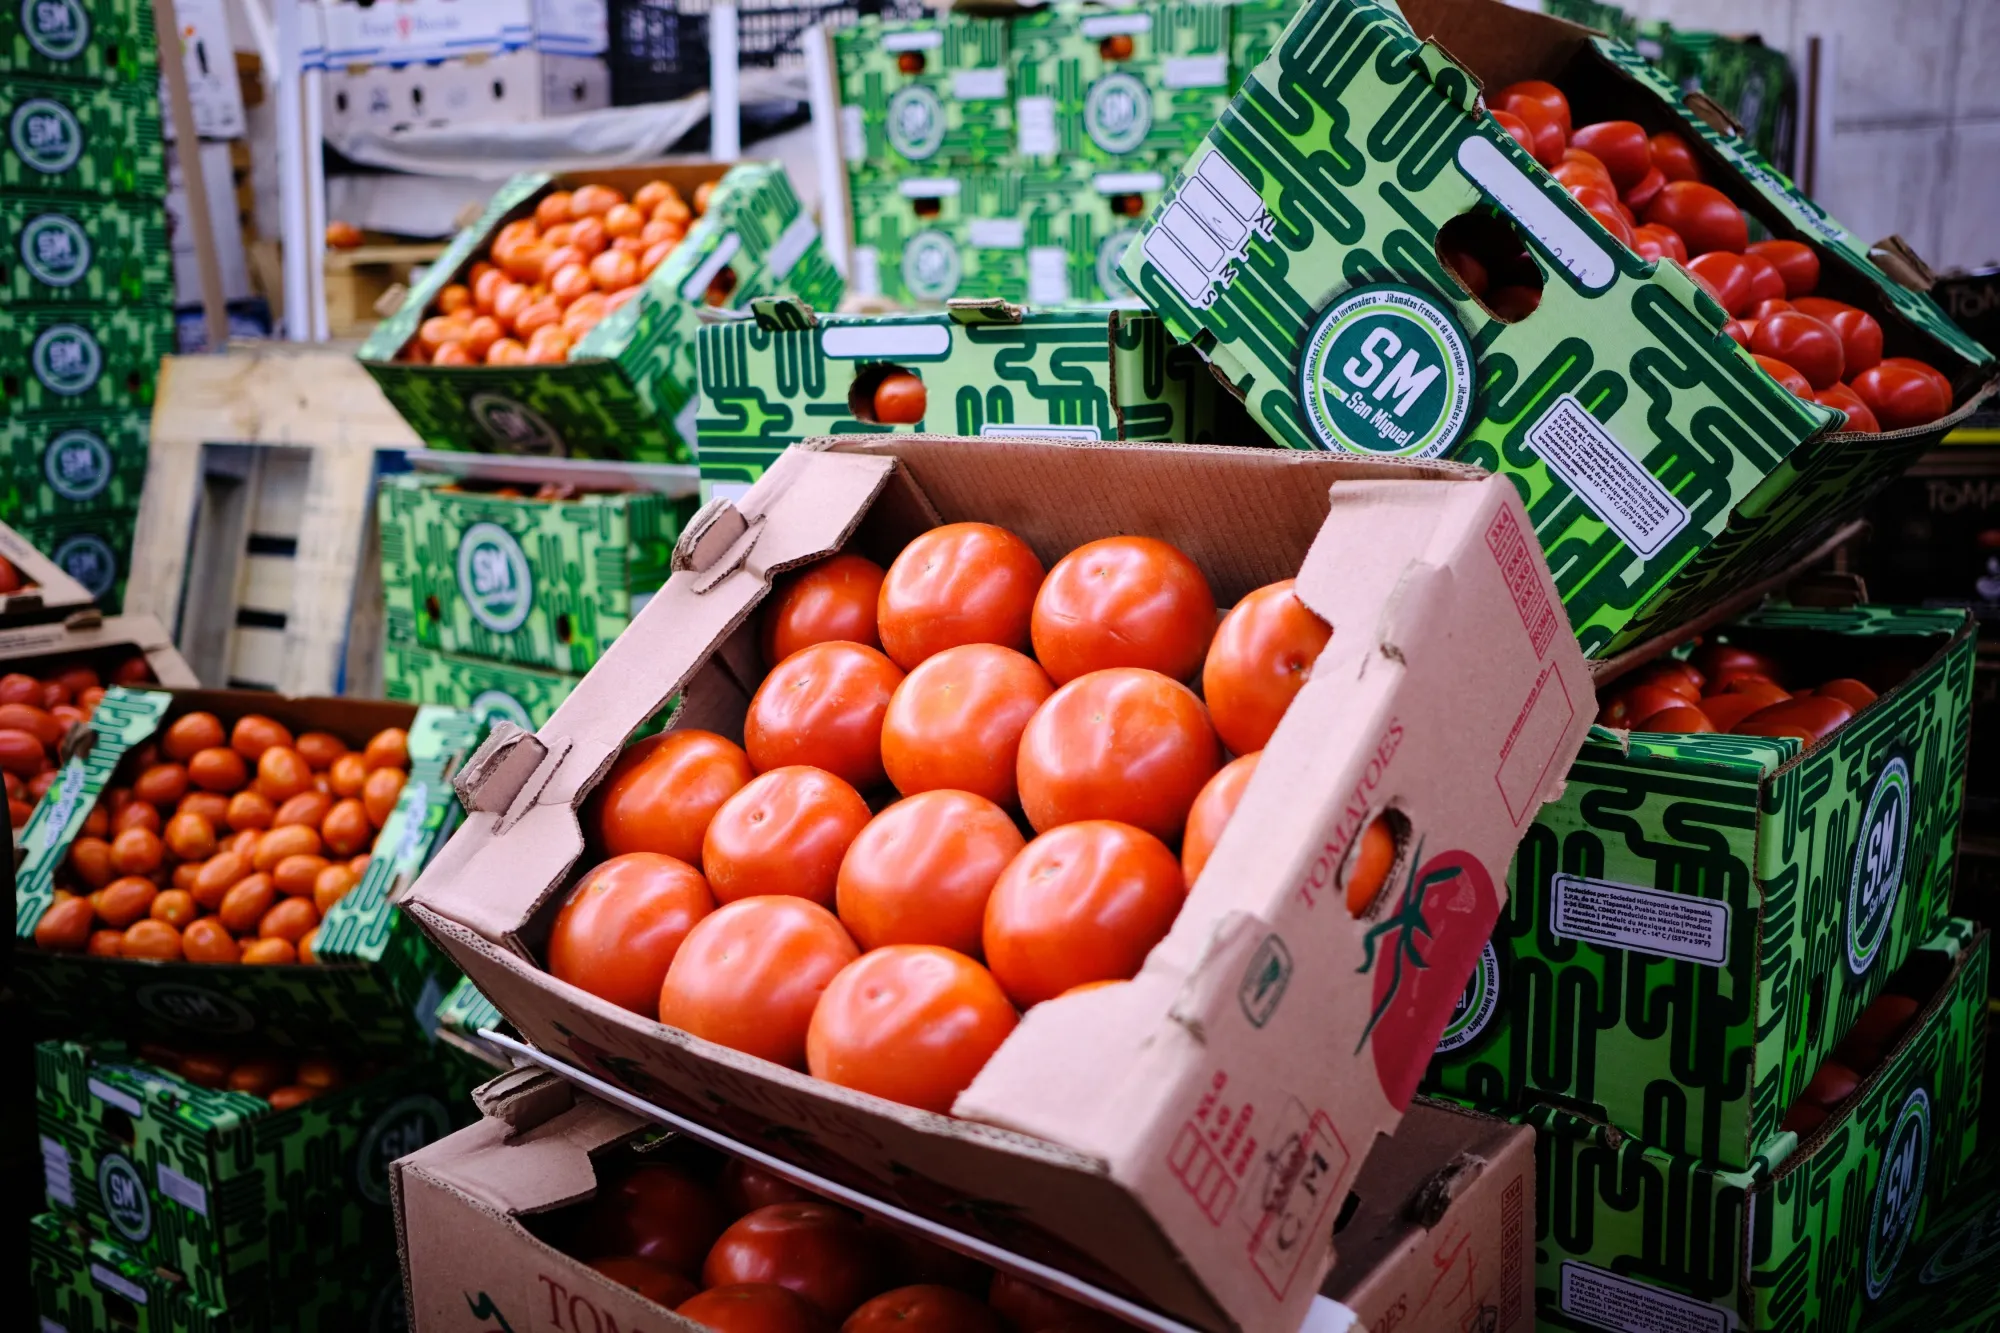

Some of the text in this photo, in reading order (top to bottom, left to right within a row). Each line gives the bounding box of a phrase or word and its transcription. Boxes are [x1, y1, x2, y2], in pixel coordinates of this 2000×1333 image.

[1254, 208, 1275, 237] XL
[1239, 239, 1251, 257] L
[1219, 263, 1237, 284] M
[1202, 290, 1216, 305] S
[1384, 293, 1417, 310] Jitomates
[1418, 303, 1442, 326] Frescos
[1440, 324, 1448, 334] de
[1314, 322, 1333, 348] Frescos
[1333, 315, 1340, 324] de
[1343, 327, 1441, 417] SM
[1453, 383, 1467, 418] Jitomates
[1346, 392, 1415, 447] San Miguel
[1437, 418, 1458, 444] Frescos
[473, 552, 510, 596] SM
[1533, 608, 1553, 645] ROMA
[1499, 686, 1538, 760] DISTRIBUTED
[1299, 716, 1405, 907] TOMATOES
[1863, 797, 1899, 907] SM
[111, 1174, 136, 1207] SM
